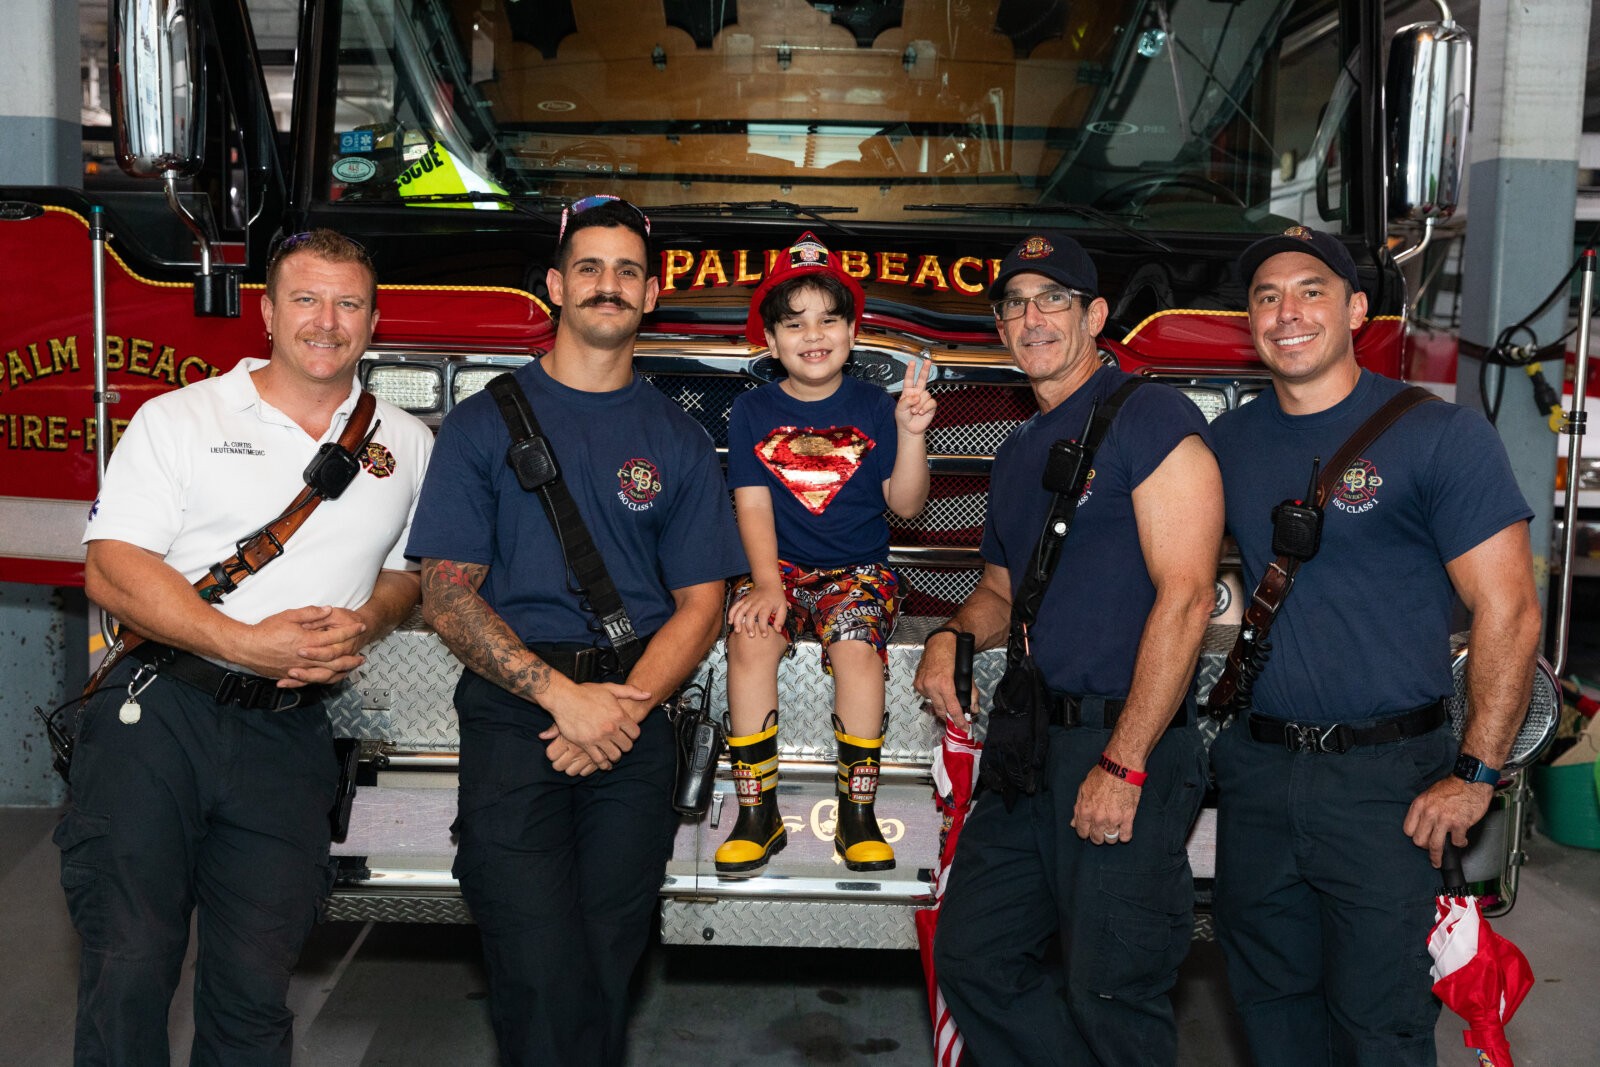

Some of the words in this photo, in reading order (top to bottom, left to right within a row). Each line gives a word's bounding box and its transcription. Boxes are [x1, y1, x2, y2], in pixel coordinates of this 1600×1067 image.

[397, 144, 444, 188] SCUE
[660, 250, 780, 294] PAL
[0, 335, 80, 391] ALM
[105, 335, 221, 388] BEAC
[617, 490, 629, 505] ISO
[628, 502, 649, 512] CLASS
[1332, 497, 1346, 511] ISO
[1346, 501, 1374, 514] CLASS
[851, 776, 878, 792] 282
